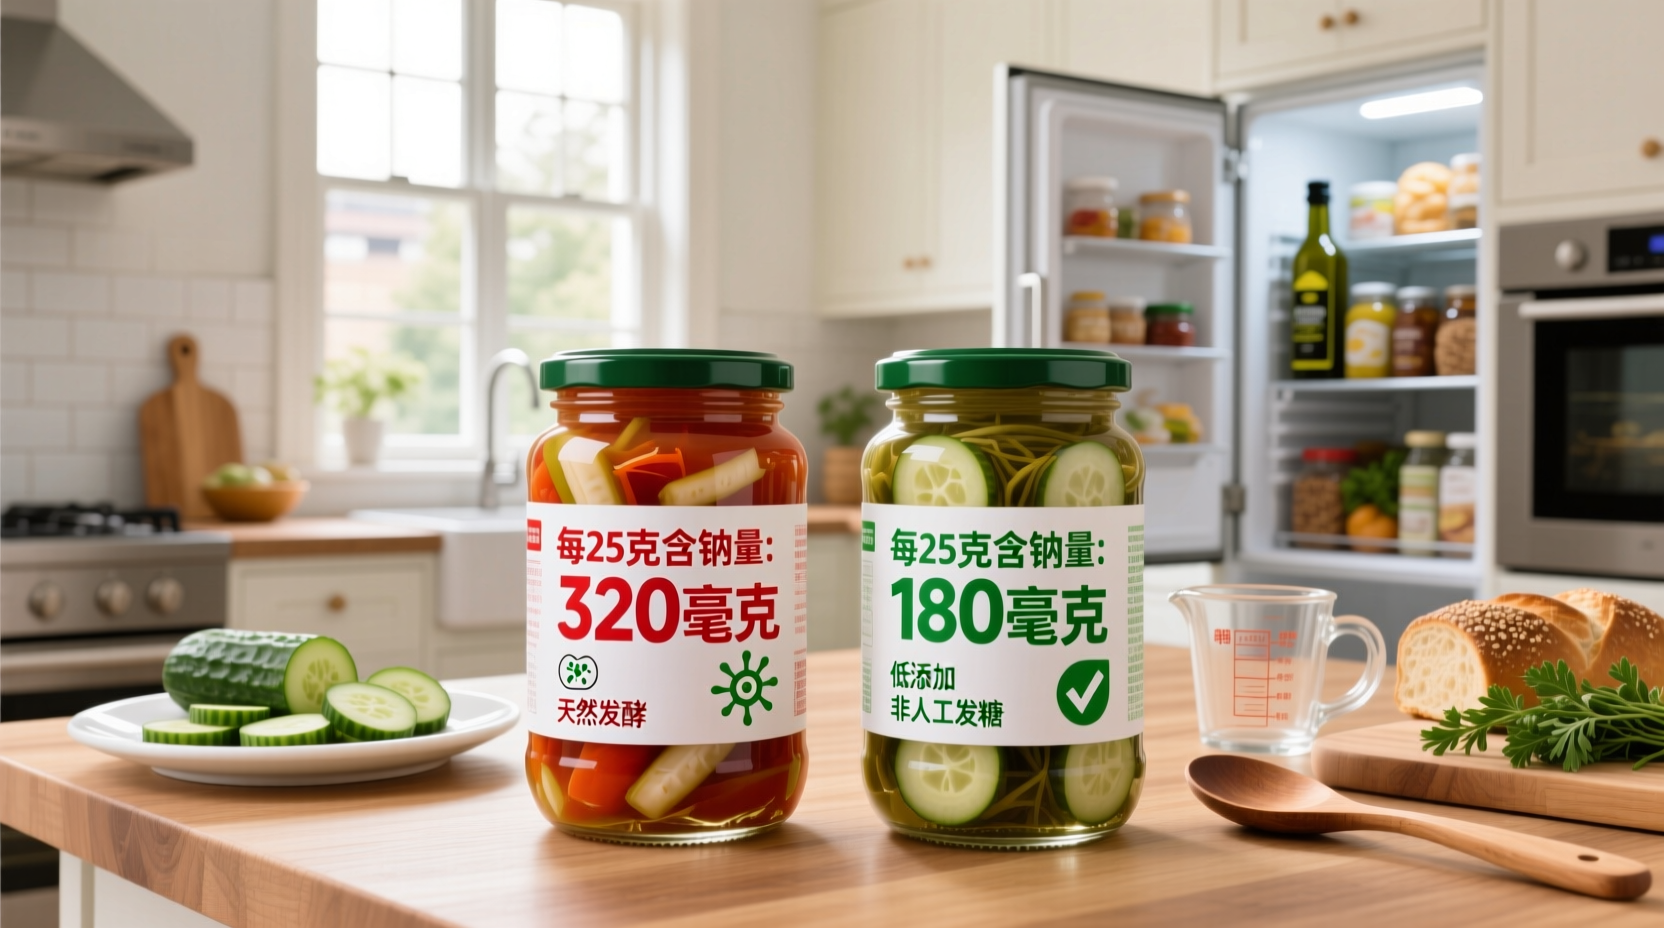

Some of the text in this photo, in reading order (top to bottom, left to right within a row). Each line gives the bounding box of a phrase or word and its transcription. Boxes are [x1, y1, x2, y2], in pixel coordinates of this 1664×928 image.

[558, 575, 780, 644] 320毫克
[891, 577, 1108, 646] 180毫克
[558, 698, 646, 728] 天然发酵
[891, 695, 1004, 728] 非人工发糖
